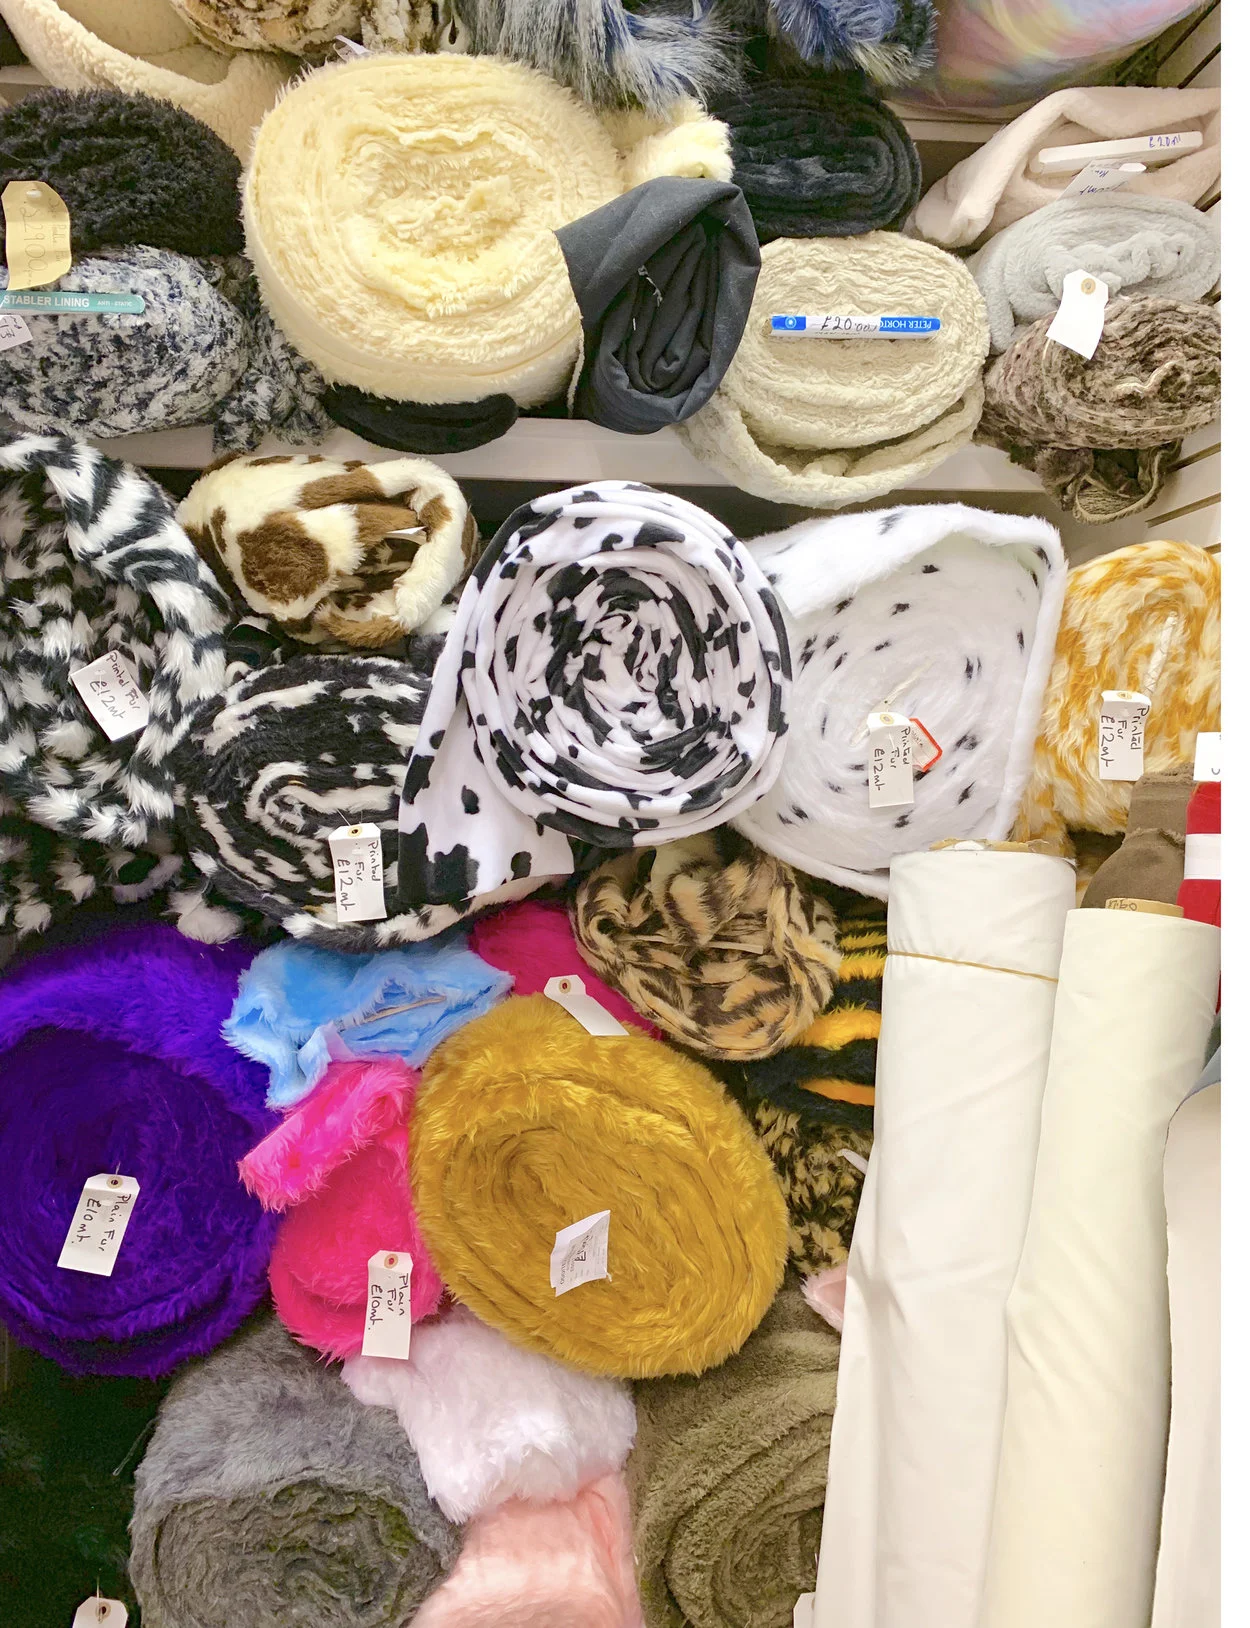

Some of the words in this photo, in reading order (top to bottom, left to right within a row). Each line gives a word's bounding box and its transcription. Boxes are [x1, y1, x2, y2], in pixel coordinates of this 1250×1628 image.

[3, 295, 52, 306] STABLER
[54, 297, 90, 308] LINING
[908, 320, 932, 330] PETER
[1117, 720, 1127, 740] Fur
[354, 861, 364, 881] Fur
[111, 1194, 132, 1222] Plain
[98, 1229, 115, 1252] Fur
[387, 1288, 397, 1311] Fur
[399, 1273, 410, 1316] Plain
